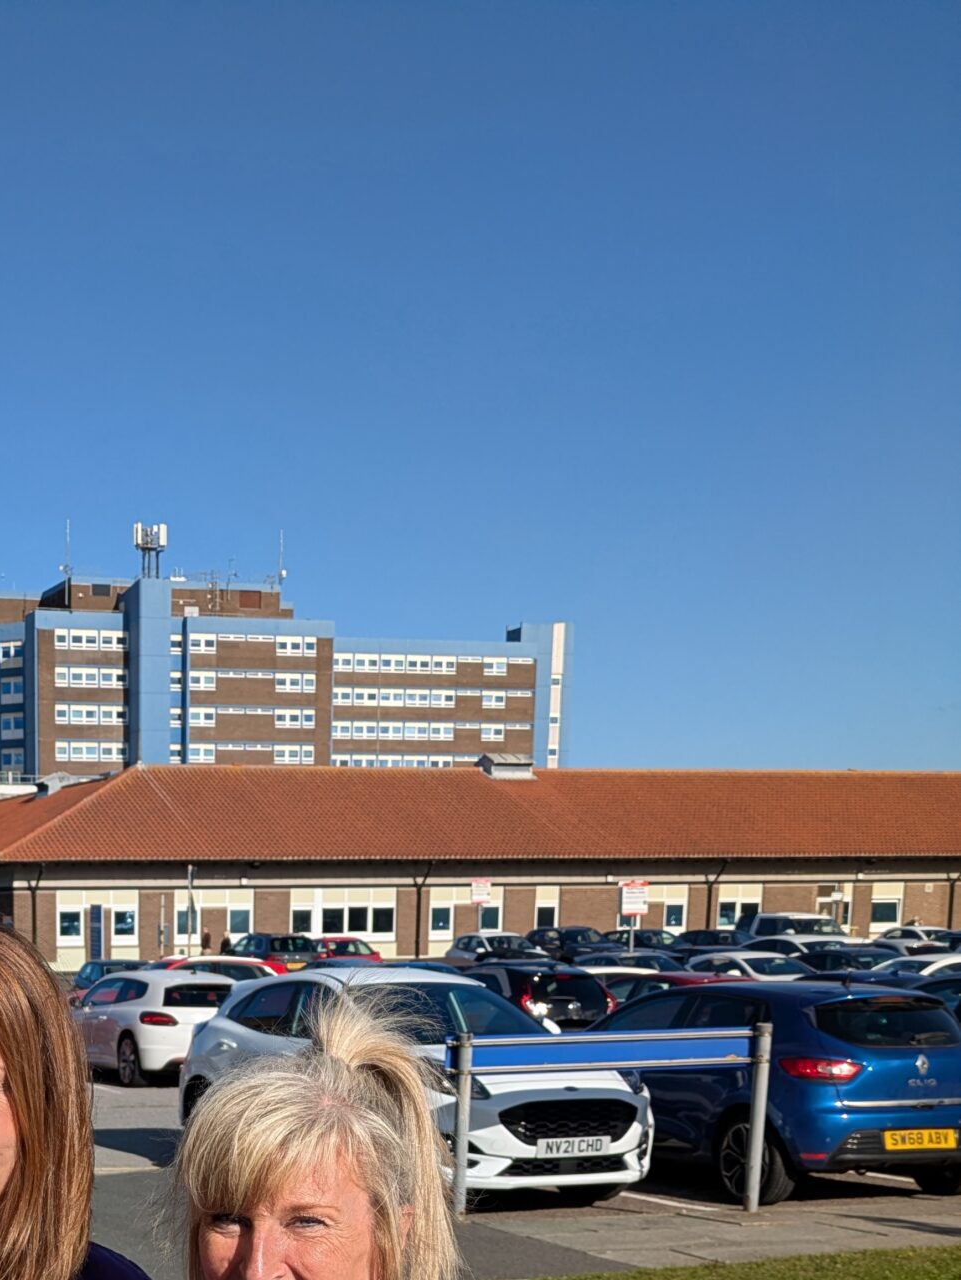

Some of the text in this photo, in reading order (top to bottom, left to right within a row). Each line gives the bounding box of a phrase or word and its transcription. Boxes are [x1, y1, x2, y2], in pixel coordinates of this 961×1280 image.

[907, 1078, 937, 1087] CLIO
[578, 1138, 603, 1152] CHD
[890, 1132, 924, 1146] SW68
